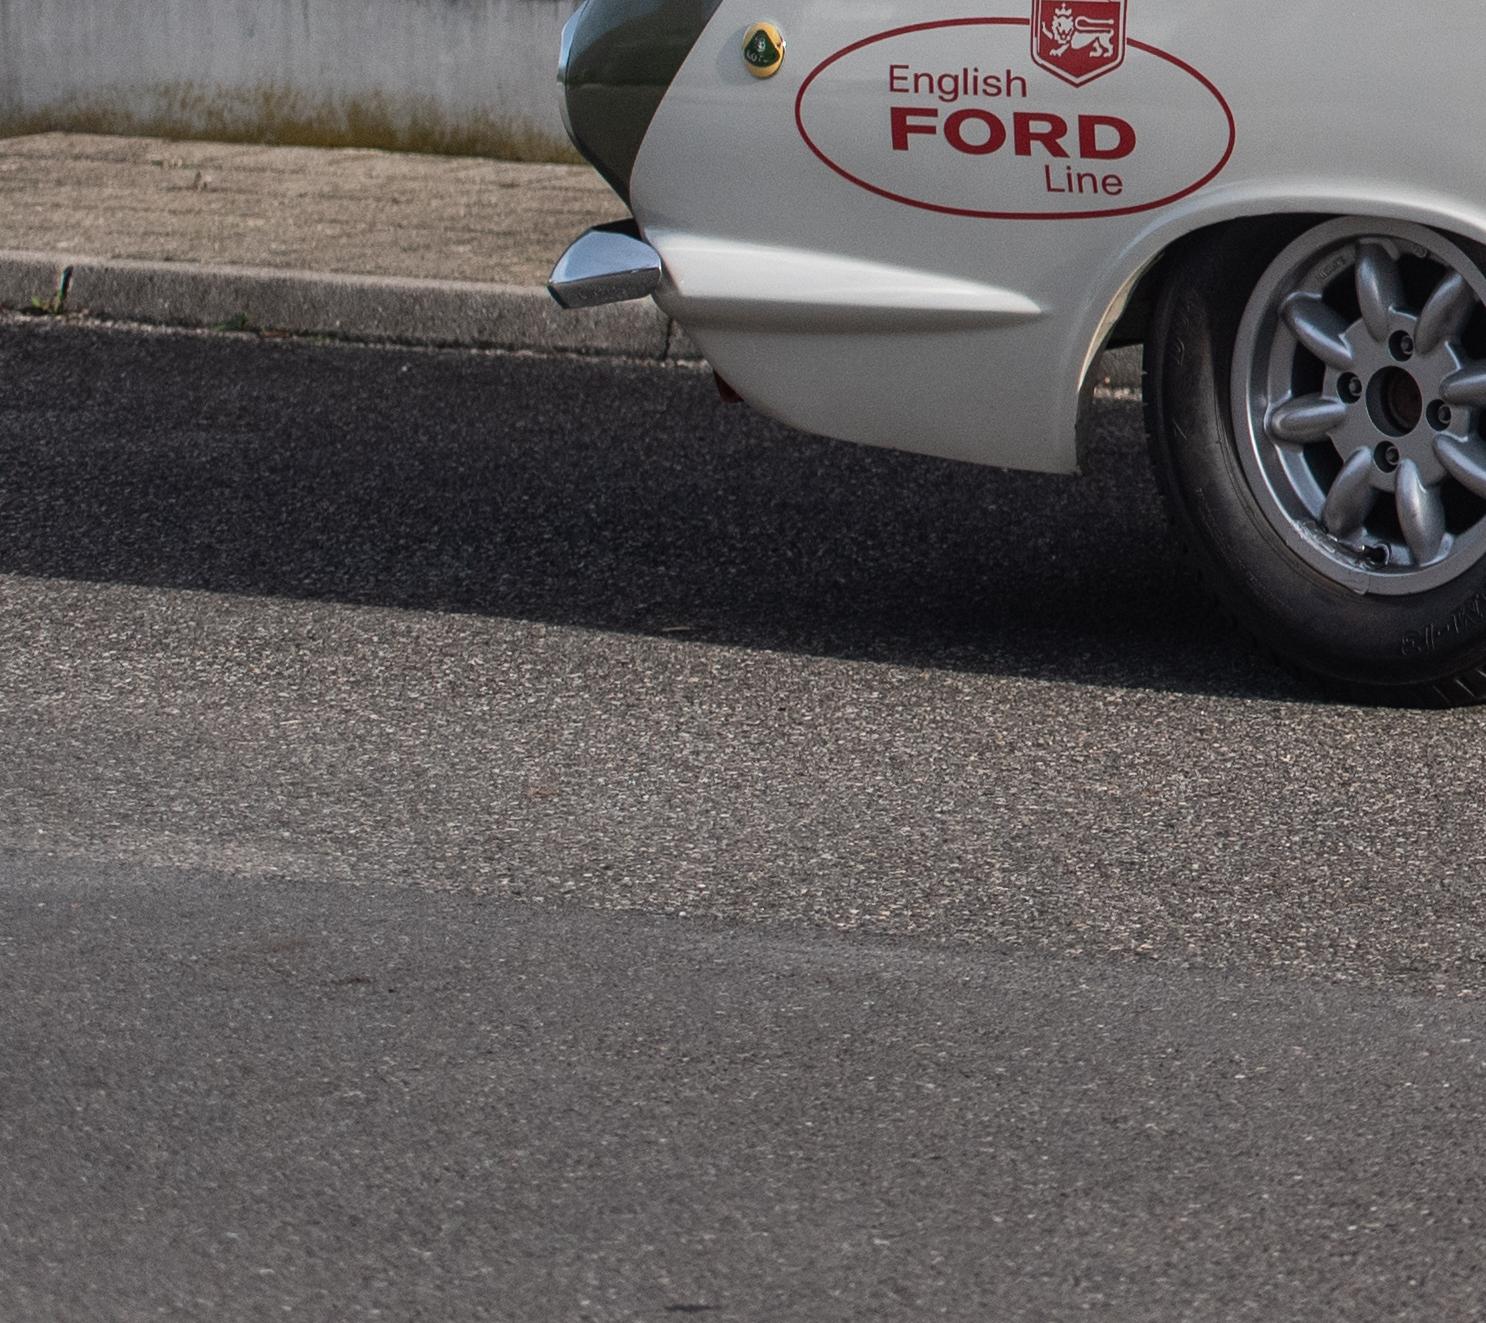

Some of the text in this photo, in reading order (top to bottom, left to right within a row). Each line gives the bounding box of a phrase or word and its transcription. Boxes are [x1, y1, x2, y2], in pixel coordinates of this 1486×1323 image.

[889, 64, 1028, 103] English
[890, 106, 1137, 160] FORD
[1044, 164, 1124, 196] Line
